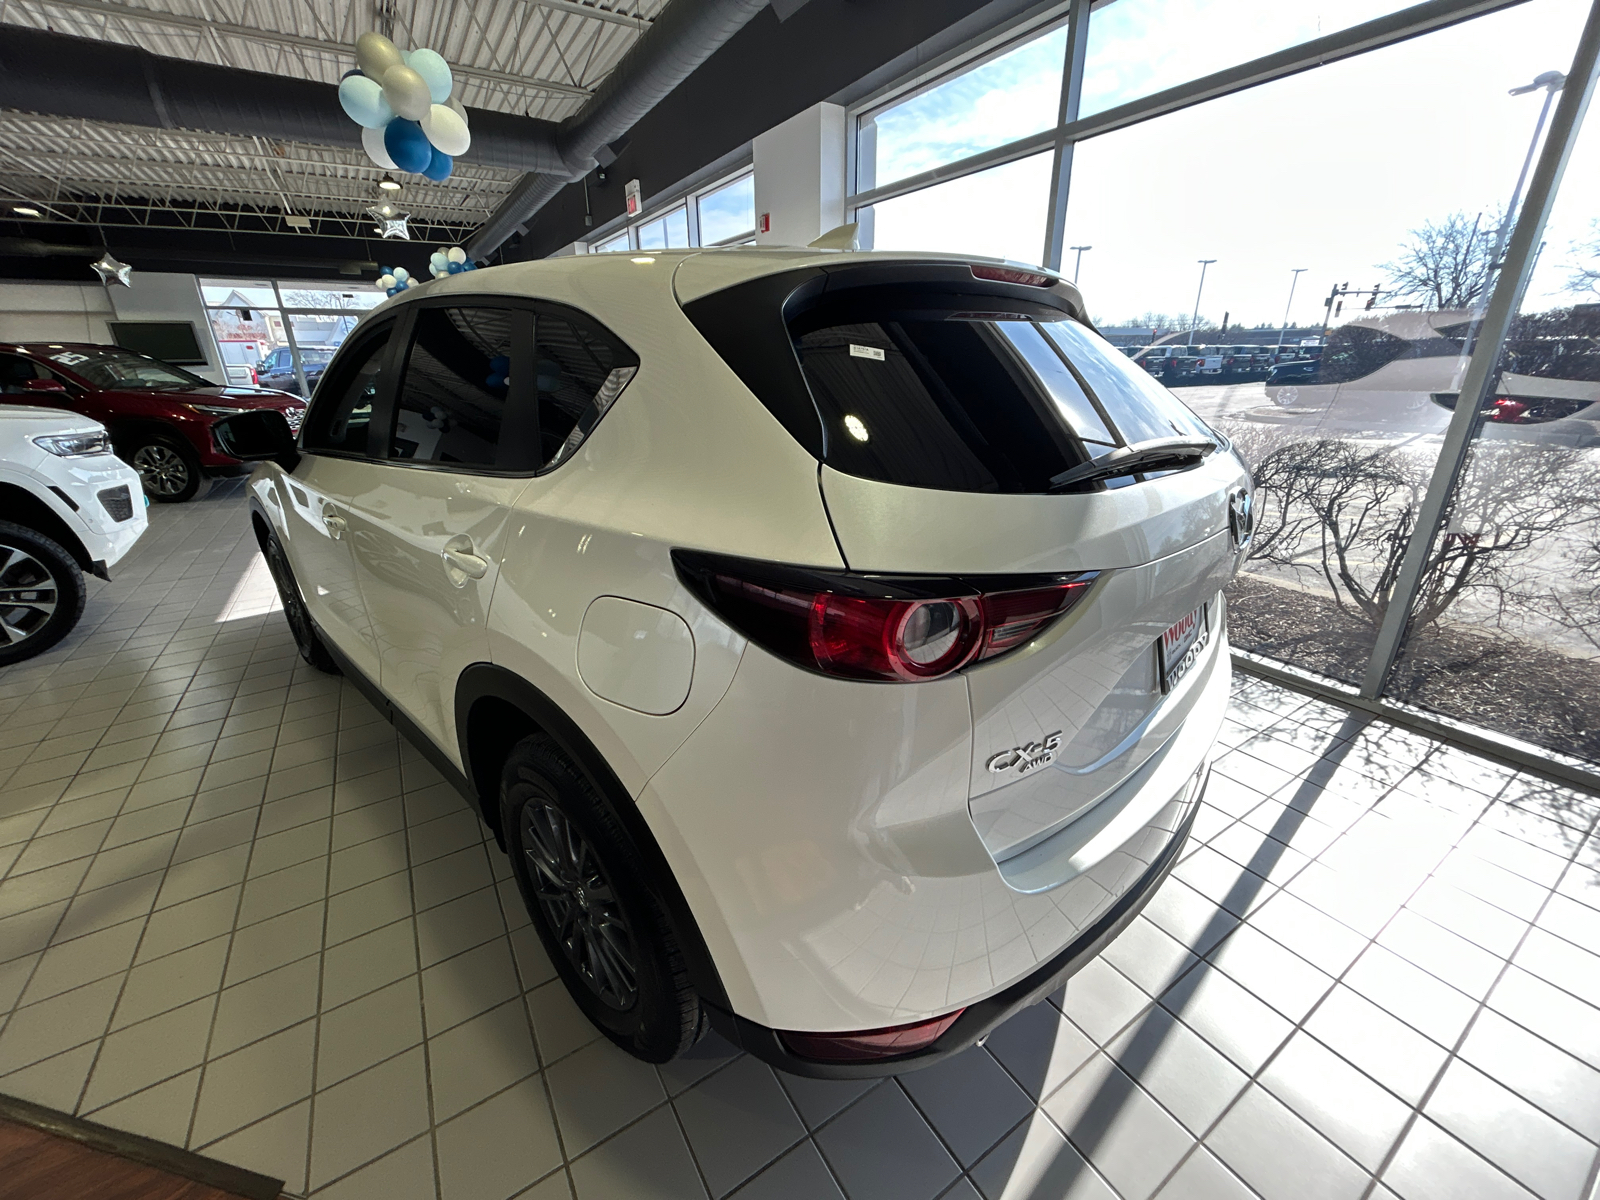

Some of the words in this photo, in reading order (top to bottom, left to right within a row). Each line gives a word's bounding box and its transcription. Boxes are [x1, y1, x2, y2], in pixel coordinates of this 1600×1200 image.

[1166, 631, 1209, 691] WOODY
[985, 729, 1063, 773] CX-5
[1019, 752, 1054, 773] AWD
